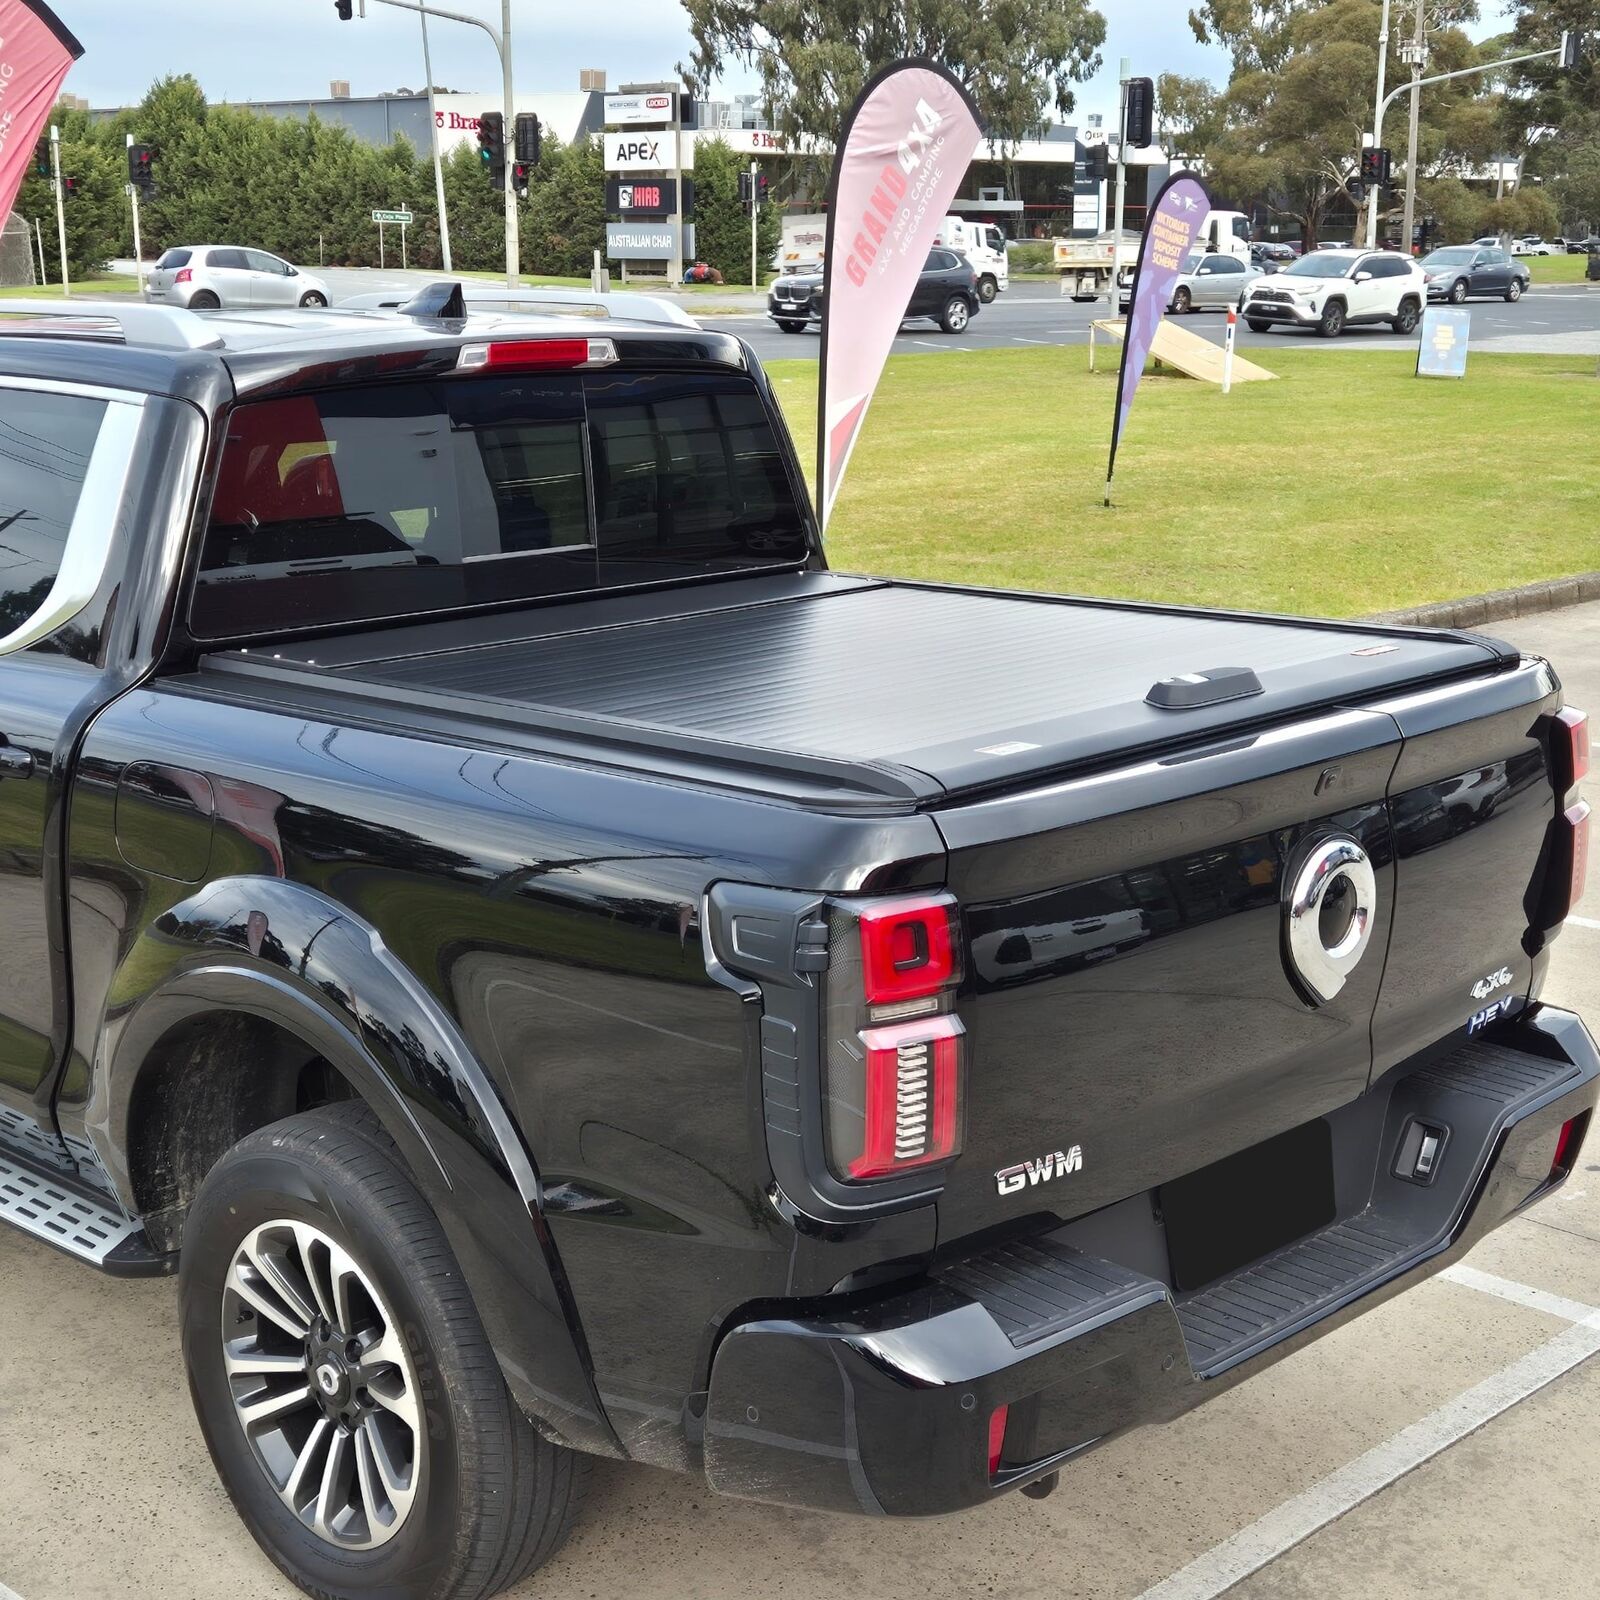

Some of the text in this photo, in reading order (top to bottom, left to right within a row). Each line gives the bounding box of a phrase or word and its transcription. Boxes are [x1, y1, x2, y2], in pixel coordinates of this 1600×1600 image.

[647, 98, 668, 107] LOCKER
[617, 137, 660, 164] APEX
[634, 187, 660, 207] HIAB
[845, 97, 943, 288] GRAND 4X4
[893, 208, 910, 241] AND
[911, 136, 945, 200] CAMPING
[900, 169, 943, 255] MEGASTORE
[1156, 211, 1190, 233] VICTORIA'S
[608, 235, 672, 248] AUSTRALIAN CHAR
[1152, 224, 1189, 247] CONTAINER
[1154, 239, 1182, 257] DEPOSIT
[1152, 252, 1179, 270] SCHEME
[1467, 996, 1512, 1034] HEV
[994, 1145, 1082, 1195] GWM
